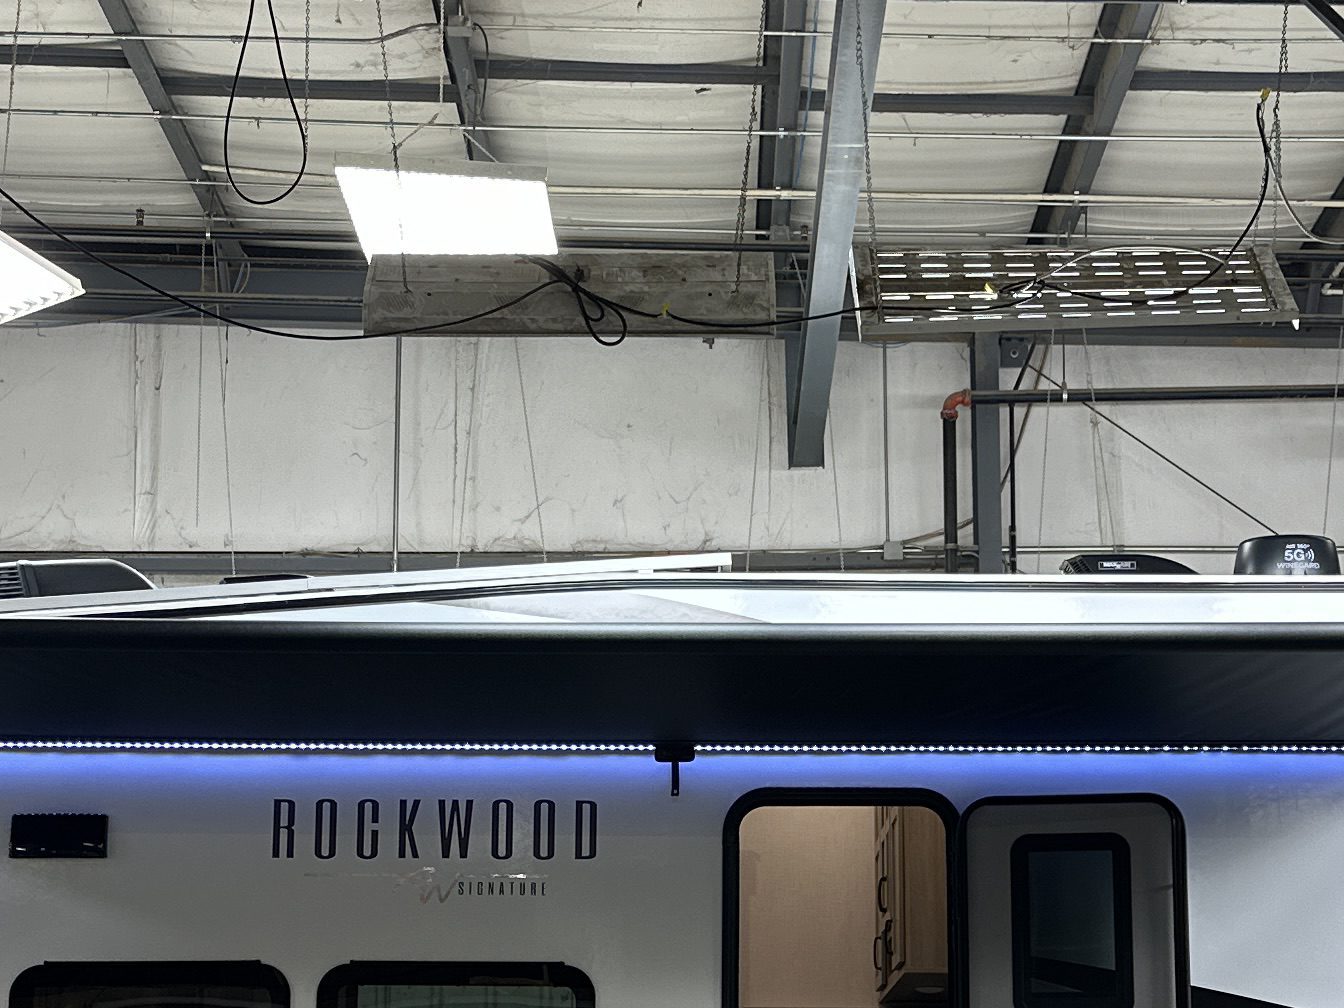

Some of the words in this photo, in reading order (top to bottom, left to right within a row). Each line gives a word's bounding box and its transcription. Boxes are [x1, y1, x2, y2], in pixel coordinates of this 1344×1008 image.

[1284, 548, 1305, 561] 5G
[271, 798, 598, 860] ROCKWOOD
[457, 881, 547, 897] SIGNATURE
